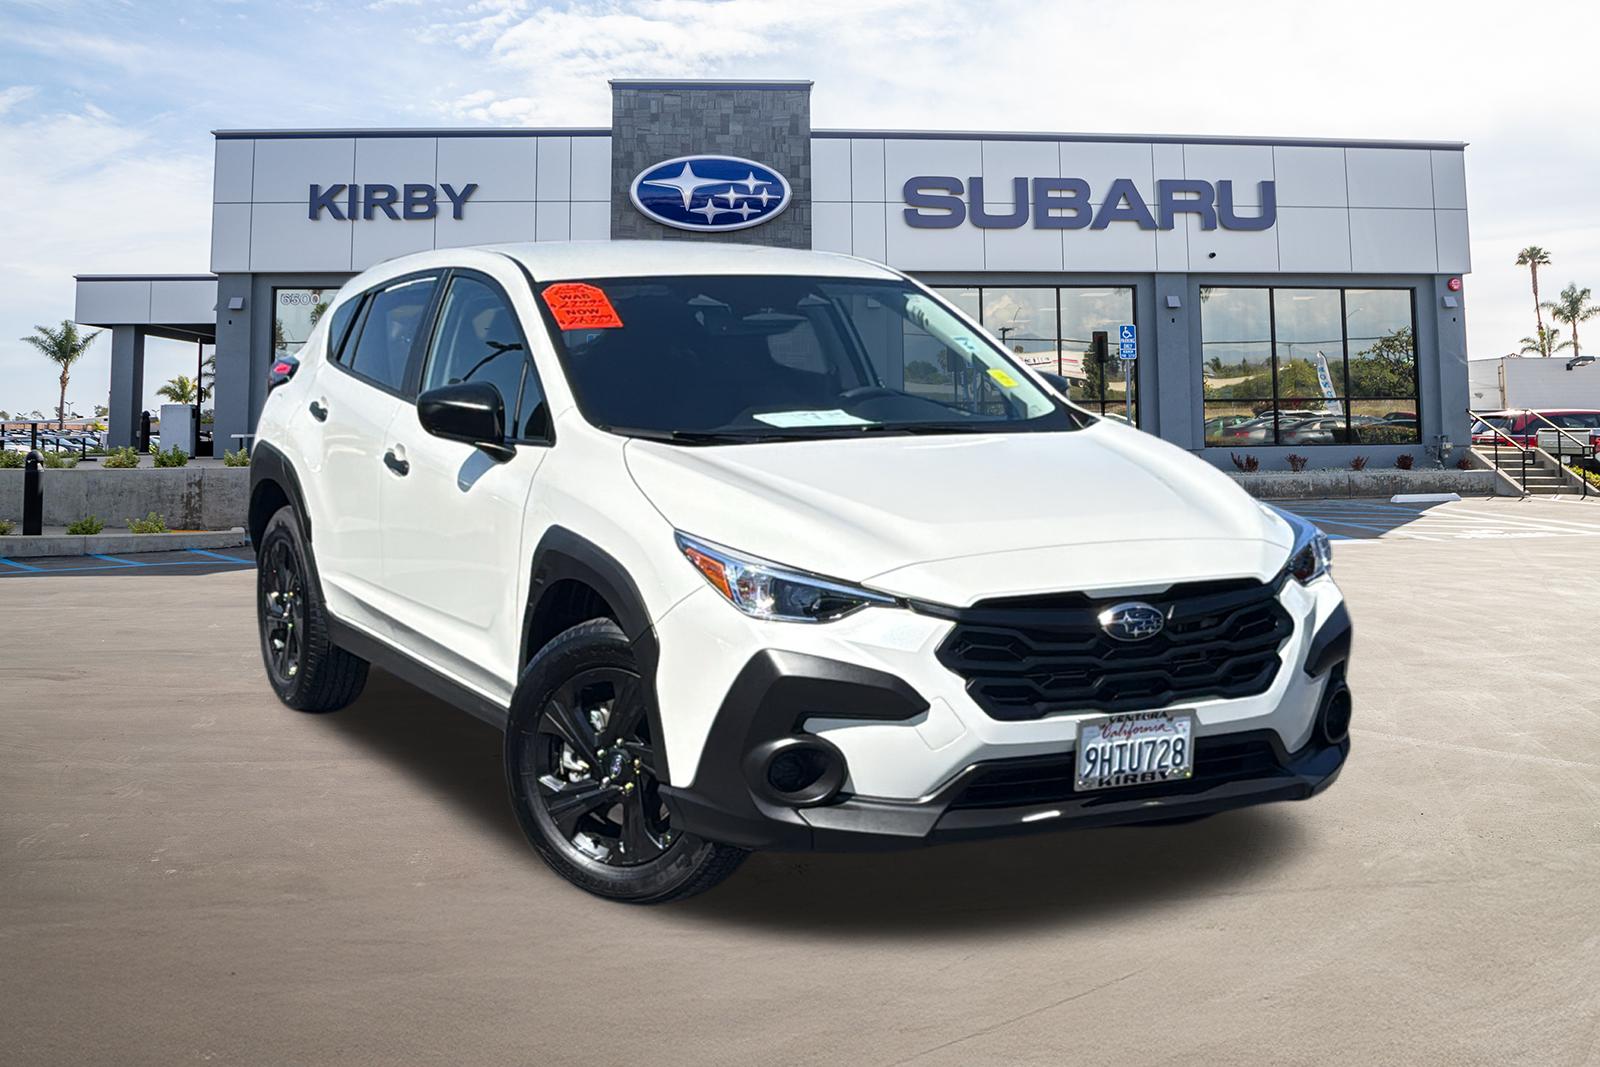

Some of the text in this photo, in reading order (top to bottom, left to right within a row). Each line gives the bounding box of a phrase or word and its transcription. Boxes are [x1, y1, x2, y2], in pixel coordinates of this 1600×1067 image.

[308, 183, 479, 221] KIRBY
[903, 175, 1277, 231] SUBARU
[280, 293, 321, 306] 6500
[1109, 711, 1169, 723] VENTURA
[1102, 722, 1173, 740] California
[1098, 770, 1169, 787] KIRBY
